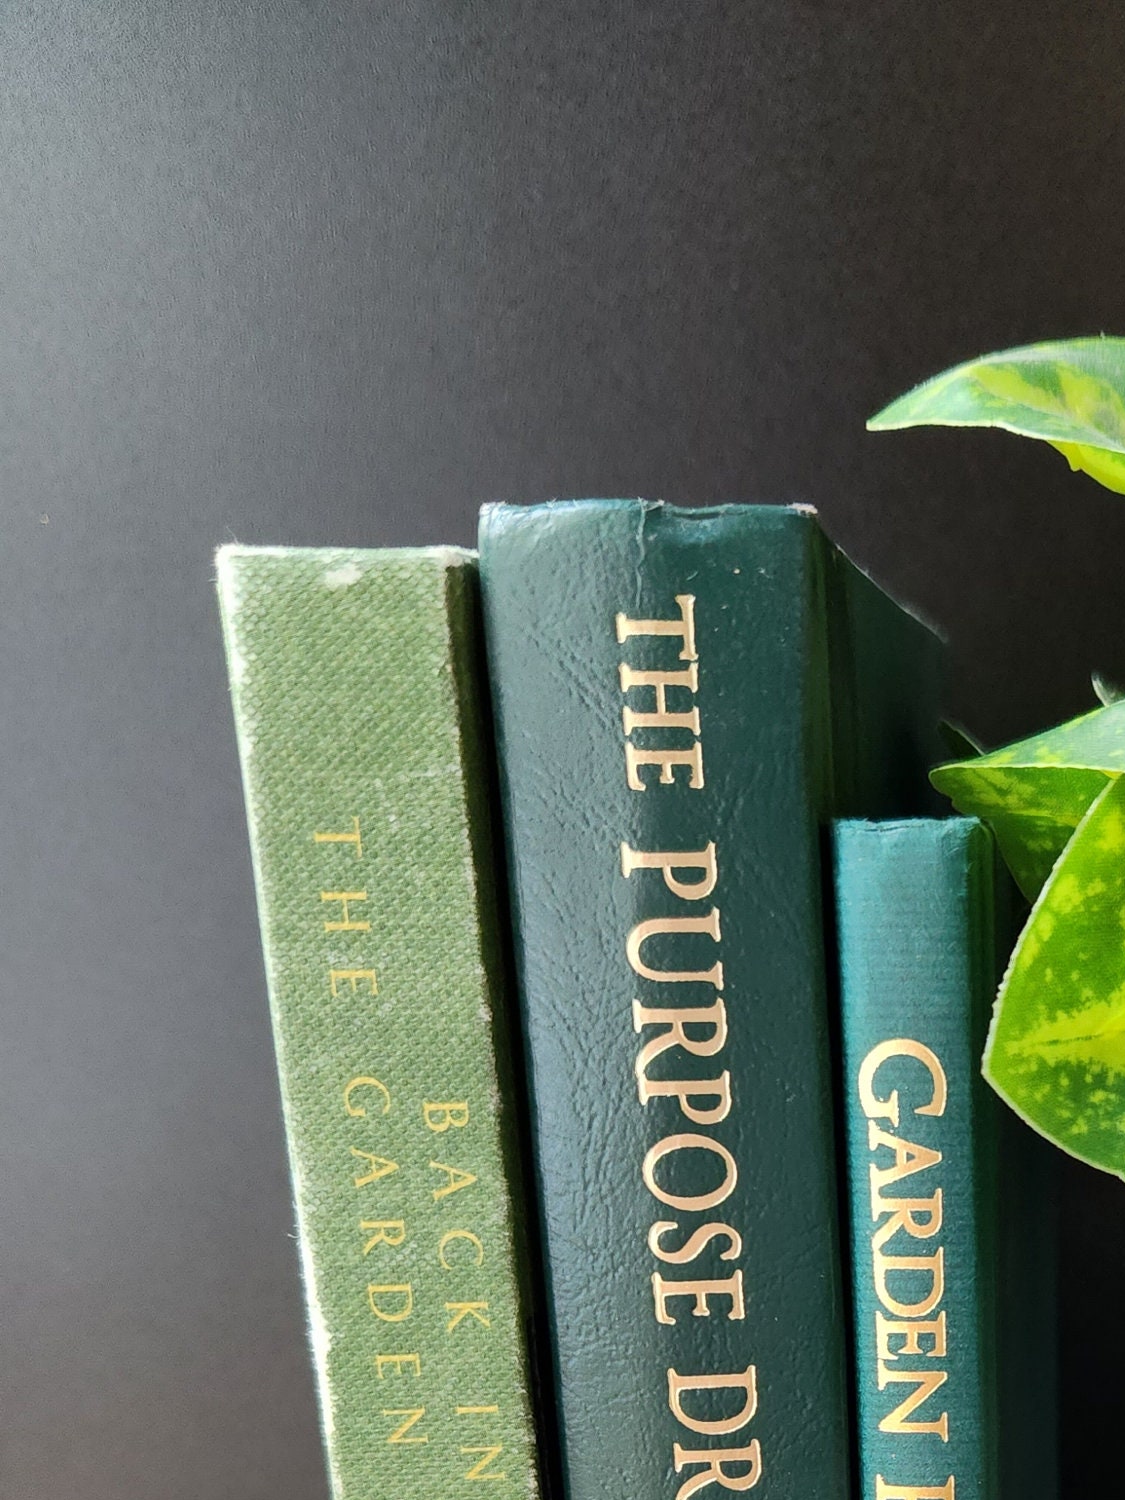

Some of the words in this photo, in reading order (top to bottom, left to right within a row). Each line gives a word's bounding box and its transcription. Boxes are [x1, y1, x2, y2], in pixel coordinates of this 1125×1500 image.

[615, 593, 706, 792] THE
[313, 816, 380, 999] THE
[620, 841, 747, 1326] PURPOSE
[344, 1075, 429, 1444] GARDEN
[423, 1101, 491, 1334] BACK
[857, 1037, 951, 1443] GARDEN
[455, 1404, 506, 1481] IN
